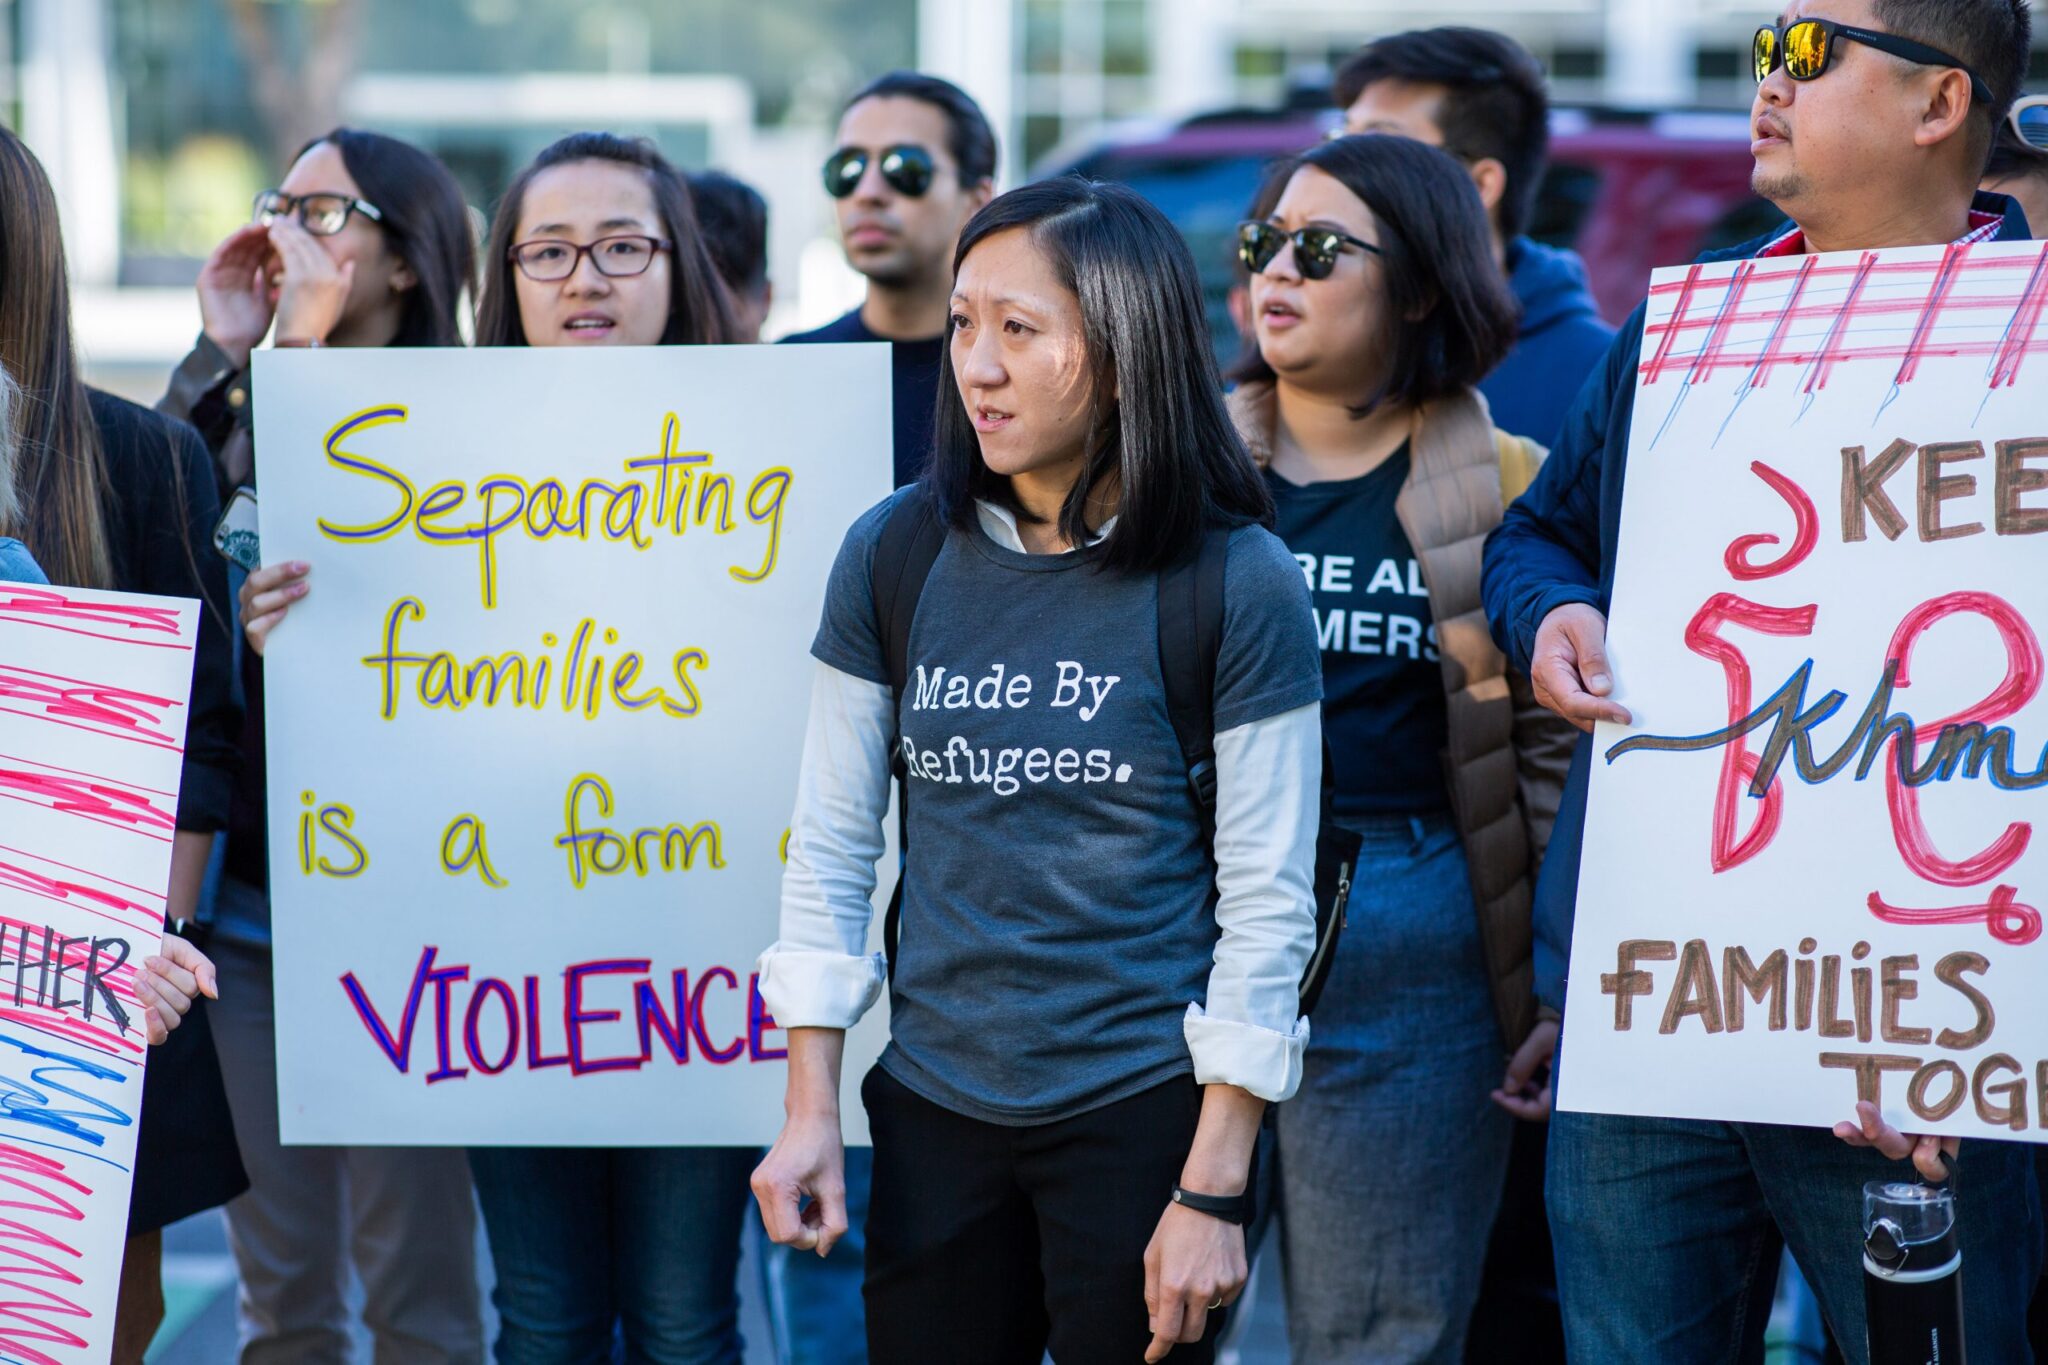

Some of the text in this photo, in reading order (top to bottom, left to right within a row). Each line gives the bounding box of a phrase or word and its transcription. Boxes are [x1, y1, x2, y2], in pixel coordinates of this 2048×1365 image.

[318, 404, 793, 609] Separating
[362, 596, 708, 720] families
[912, 660, 1121, 722] Made By
[902, 735, 1134, 796] Refugees.
[299, 791, 369, 877] is
[441, 813, 508, 887] a
[556, 773, 728, 888] form
[1818, 1051, 2048, 1131] TOG
